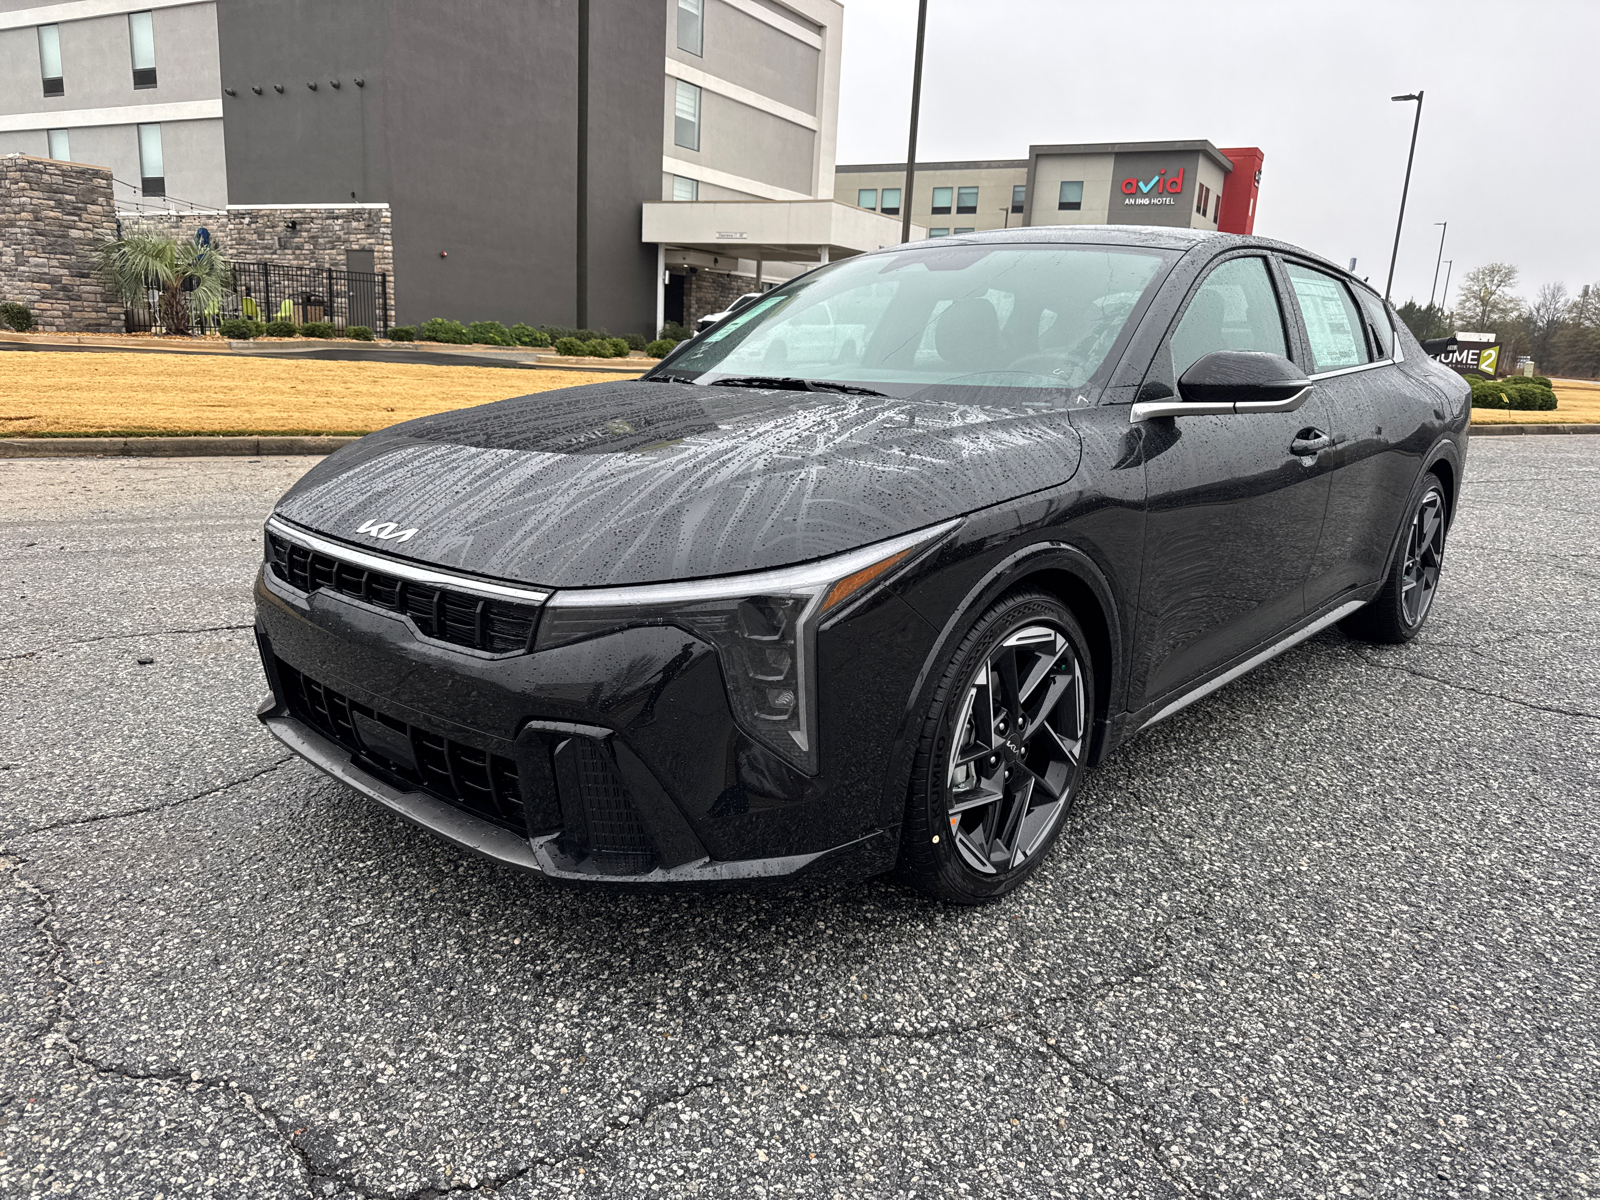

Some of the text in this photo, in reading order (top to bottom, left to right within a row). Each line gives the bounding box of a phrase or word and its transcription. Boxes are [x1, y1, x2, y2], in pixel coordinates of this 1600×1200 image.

[1121, 167, 1185, 194] avid
[1151, 197, 1175, 205] HOTEL
[1480, 349, 1496, 373] 2
[356, 519, 419, 543] KIA
[1006, 740, 1019, 756] KIA
[931, 736, 945, 819] KUMHO
